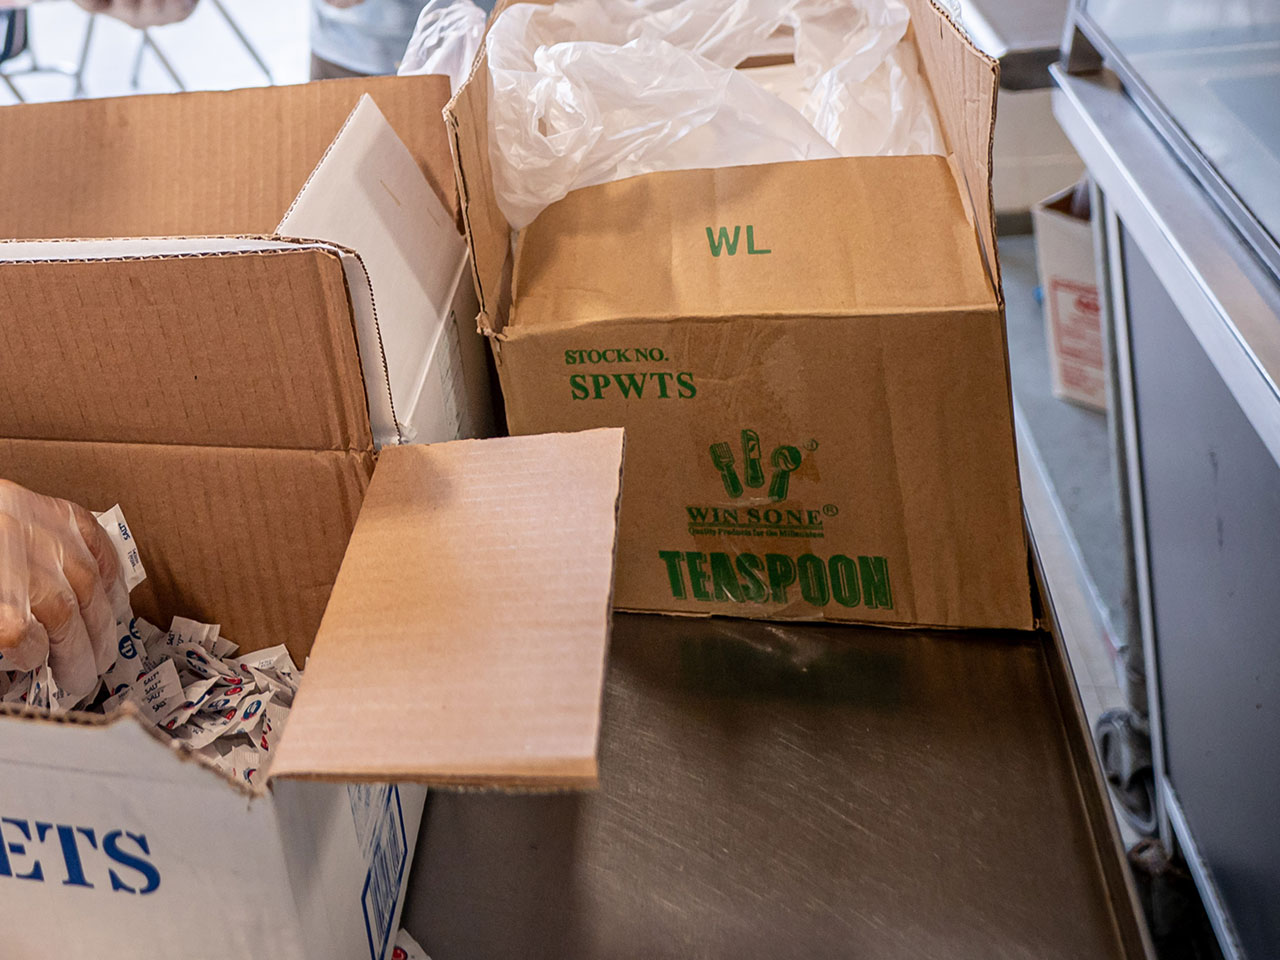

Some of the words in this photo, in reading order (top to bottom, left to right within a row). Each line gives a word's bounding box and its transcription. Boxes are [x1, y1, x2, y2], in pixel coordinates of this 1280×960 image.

[706, 225, 772, 257] WL
[565, 348, 632, 365] STOCK
[634, 347, 670, 362] NO.
[570, 371, 697, 401] SPWTS
[688, 527, 717, 537] Quality
[718, 528, 752, 537] Products
[658, 549, 894, 610] TEASPOON
